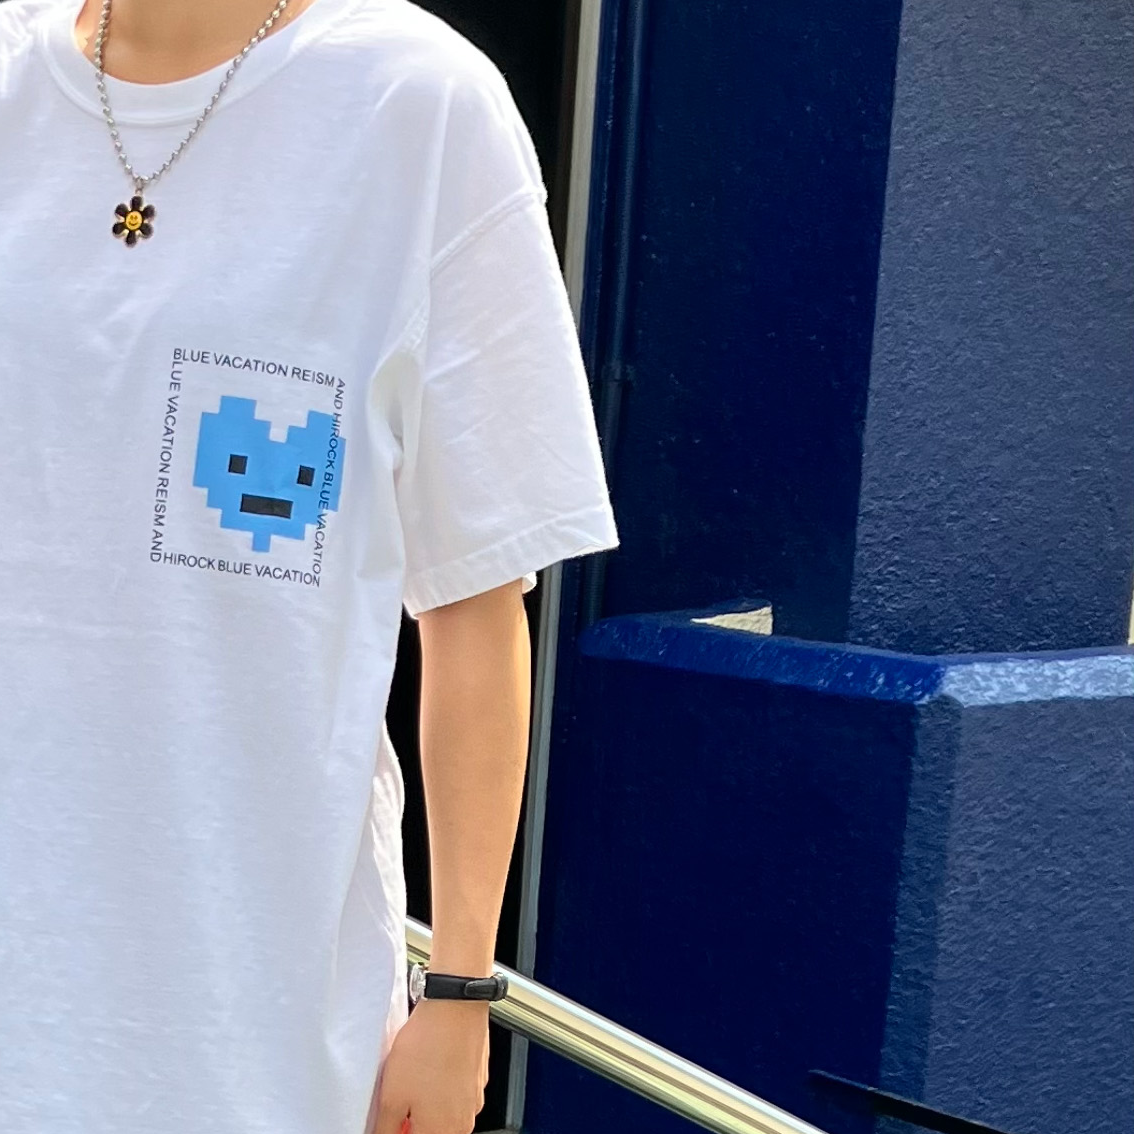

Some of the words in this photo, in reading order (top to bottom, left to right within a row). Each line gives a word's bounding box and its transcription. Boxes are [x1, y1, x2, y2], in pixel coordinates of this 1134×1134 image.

[173, 348, 211, 365] BLUE
[213, 352, 289, 378] VACATION
[291, 366, 335, 388] REISM
[333, 378, 346, 410] AND
[158, 395, 180, 474] VACATION
[325, 412, 343, 470] HIROCK
[153, 476, 170, 528] REISM
[317, 471, 334, 511] BLUE
[149, 528, 164, 563] AND
[163, 552, 216, 571] HIROCK
[217, 559, 252, 577] BLUE
[254, 563, 320, 588] VACATION
